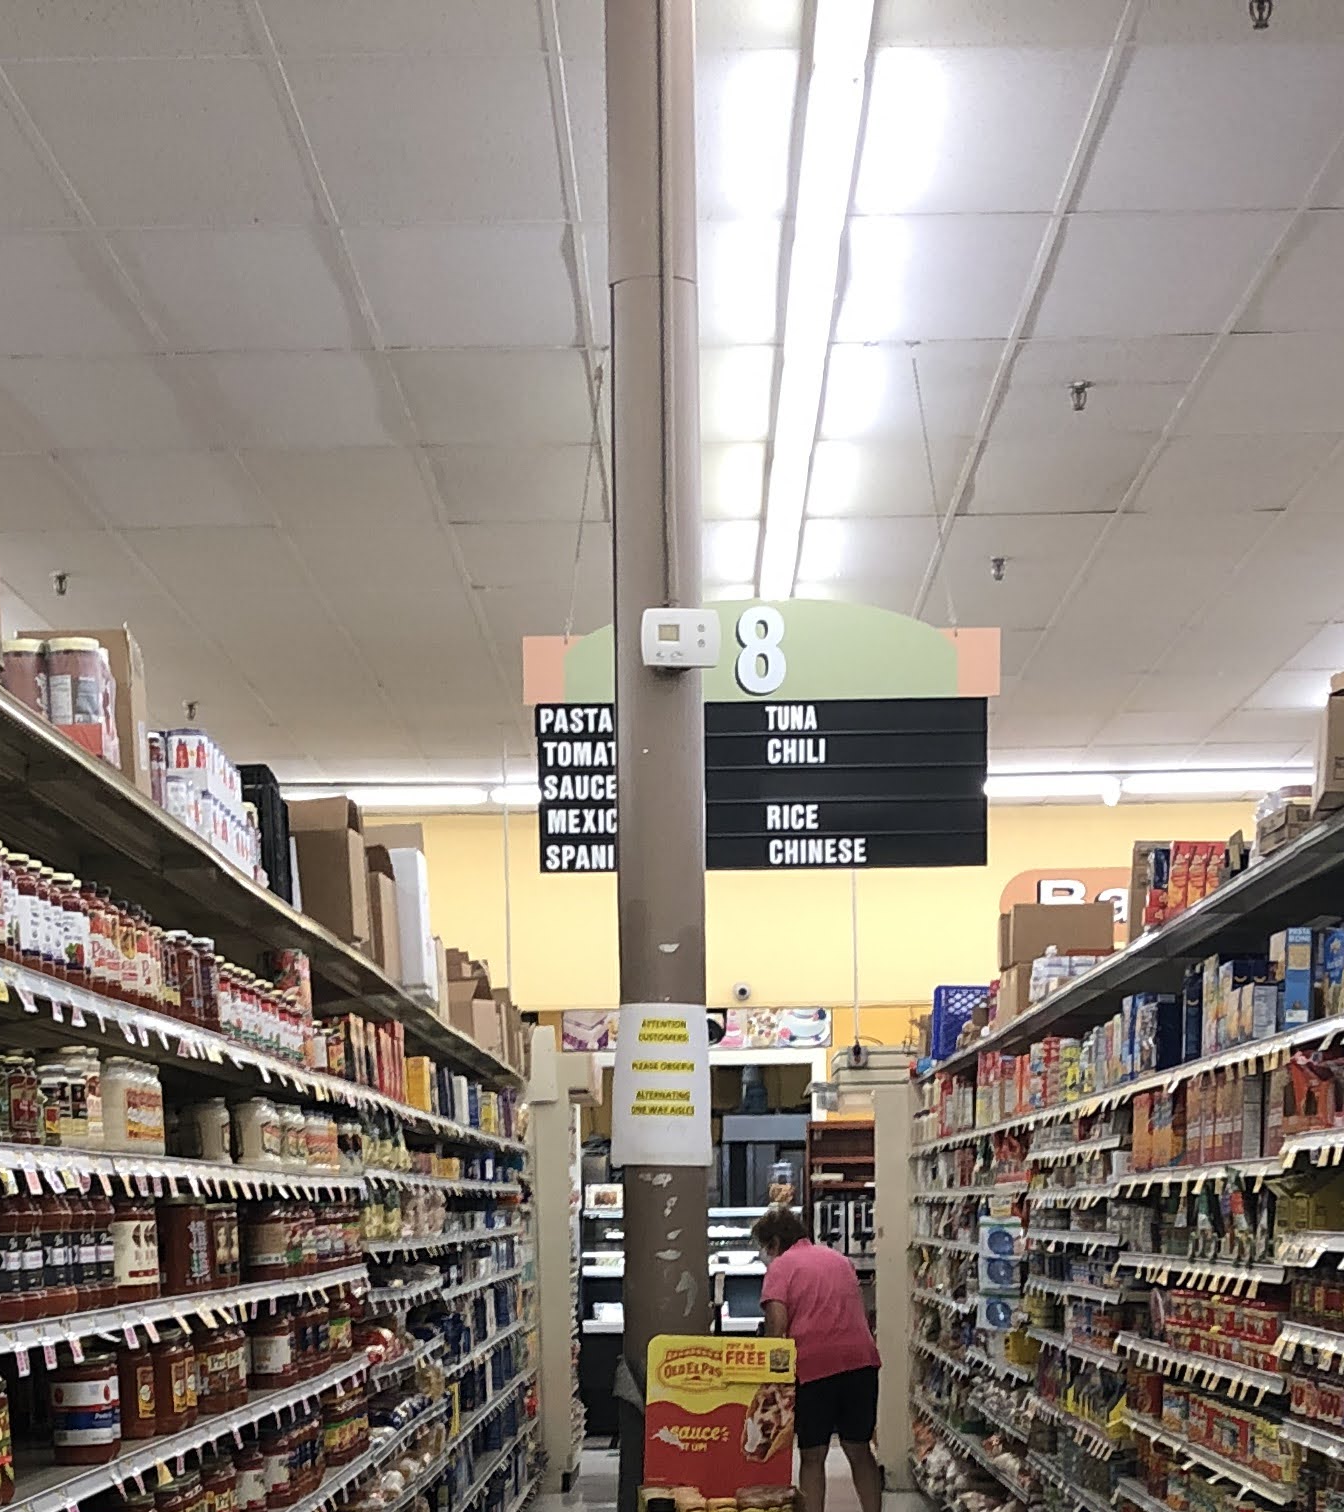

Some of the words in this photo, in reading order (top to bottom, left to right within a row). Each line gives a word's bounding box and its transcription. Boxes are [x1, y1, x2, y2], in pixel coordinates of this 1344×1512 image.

[736, 606, 787, 696] 8
[539, 709, 613, 735] PASTA
[765, 705, 818, 731] TUNA
[543, 740, 616, 767] TOMAT
[768, 739, 827, 764] CHILI
[548, 809, 617, 834] MEXIC
[766, 804, 818, 830] RICE
[546, 844, 615, 871] SPANI
[769, 839, 866, 865] CHINESE
[642, 1020, 686, 1028] ATTENTION
[661, 1063, 694, 1071] OBSERVE
[636, 1092, 690, 1100] ALTERNATING
[725, 1350, 766, 1365] FREE
